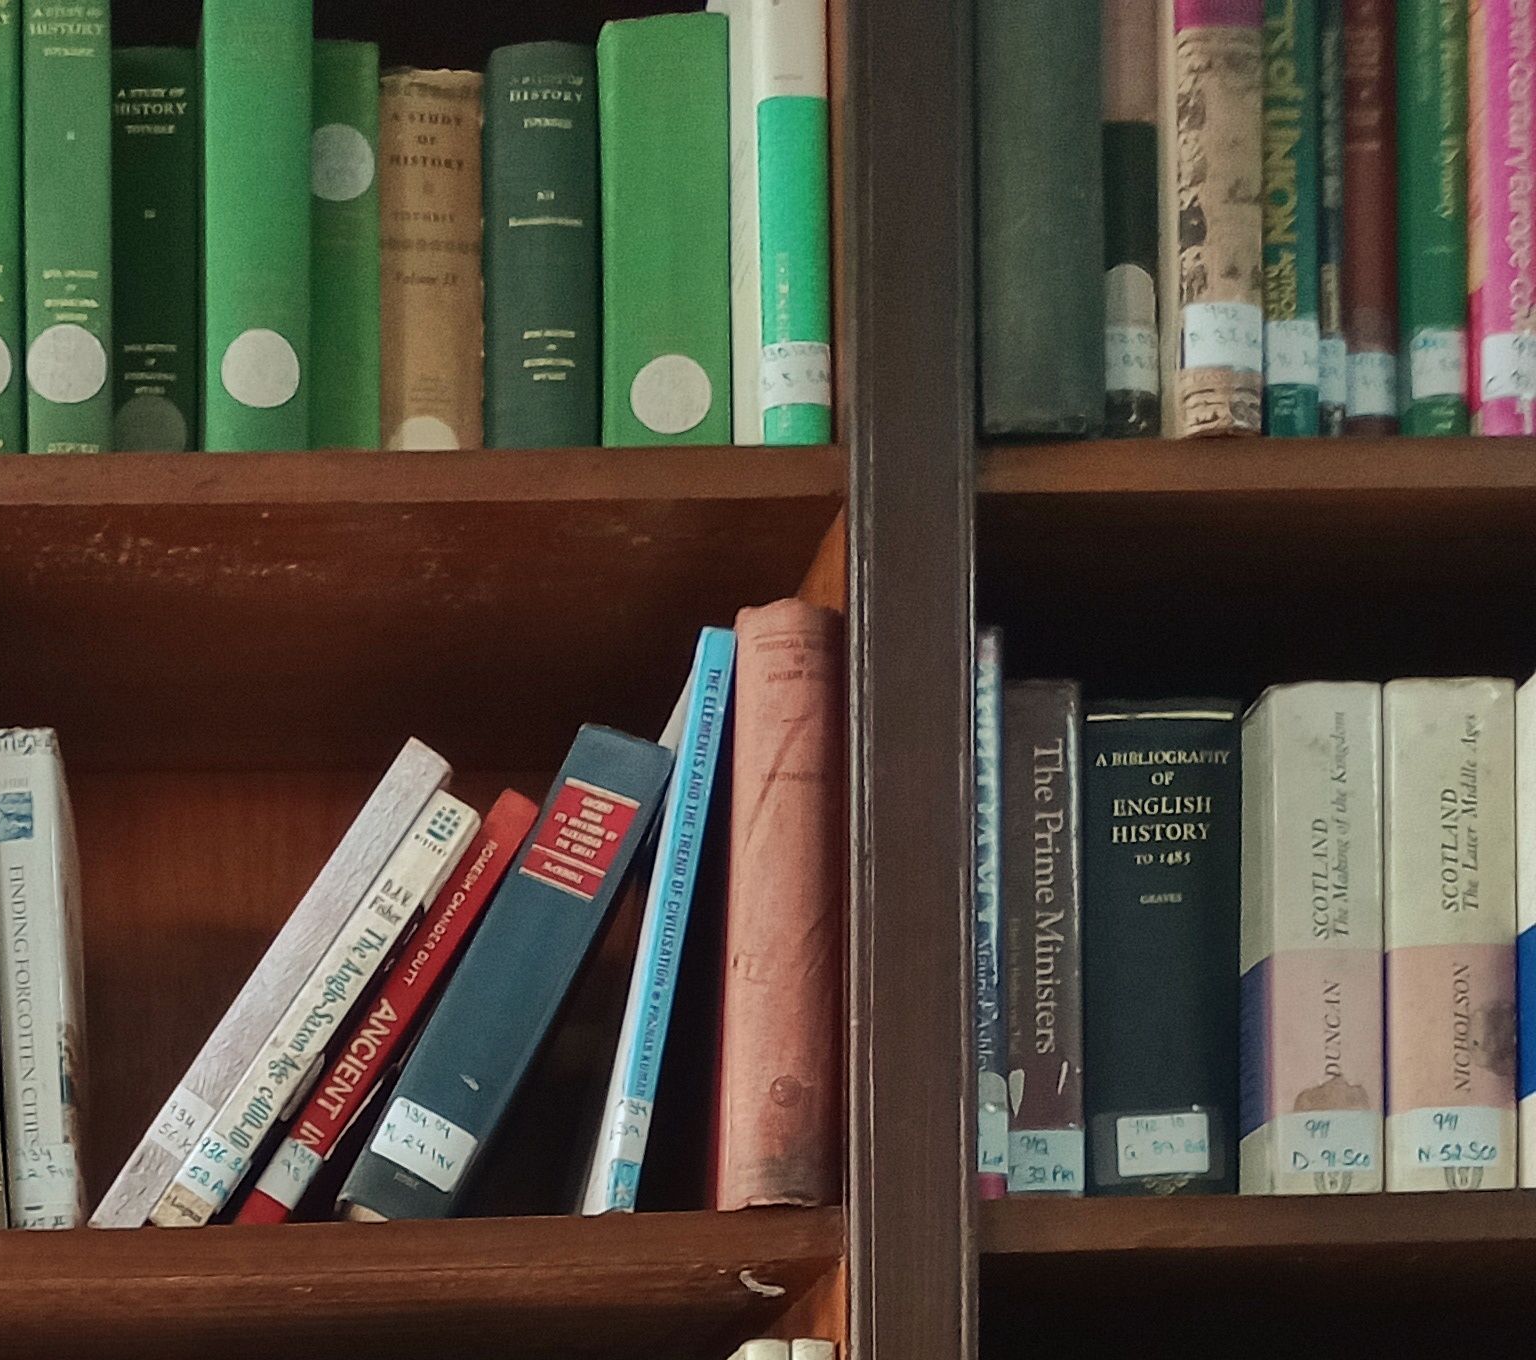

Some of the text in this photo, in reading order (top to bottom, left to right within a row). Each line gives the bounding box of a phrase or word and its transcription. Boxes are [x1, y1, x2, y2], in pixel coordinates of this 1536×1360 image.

[1095, 749, 1230, 767] A BIBLIOGRAPHY
[1151, 771, 1174, 786] OF
[1111, 796, 1213, 817] ENGLISH
[1111, 823, 1211, 844] HISTORY
[1441, 787, 1459, 912] SCOTLAND
[9, 864, 28, 951] FINDING
[1033, 737, 1064, 1056] The Prime Ministers
[1312, 817, 1330, 941] SCOTLAND
[352, 928, 388, 959] The
[403, 890, 466, 987] CHANDER DUTT
[316, 998, 398, 1122] ANCIENT
[1324, 979, 1341, 1077] DUNCAN
